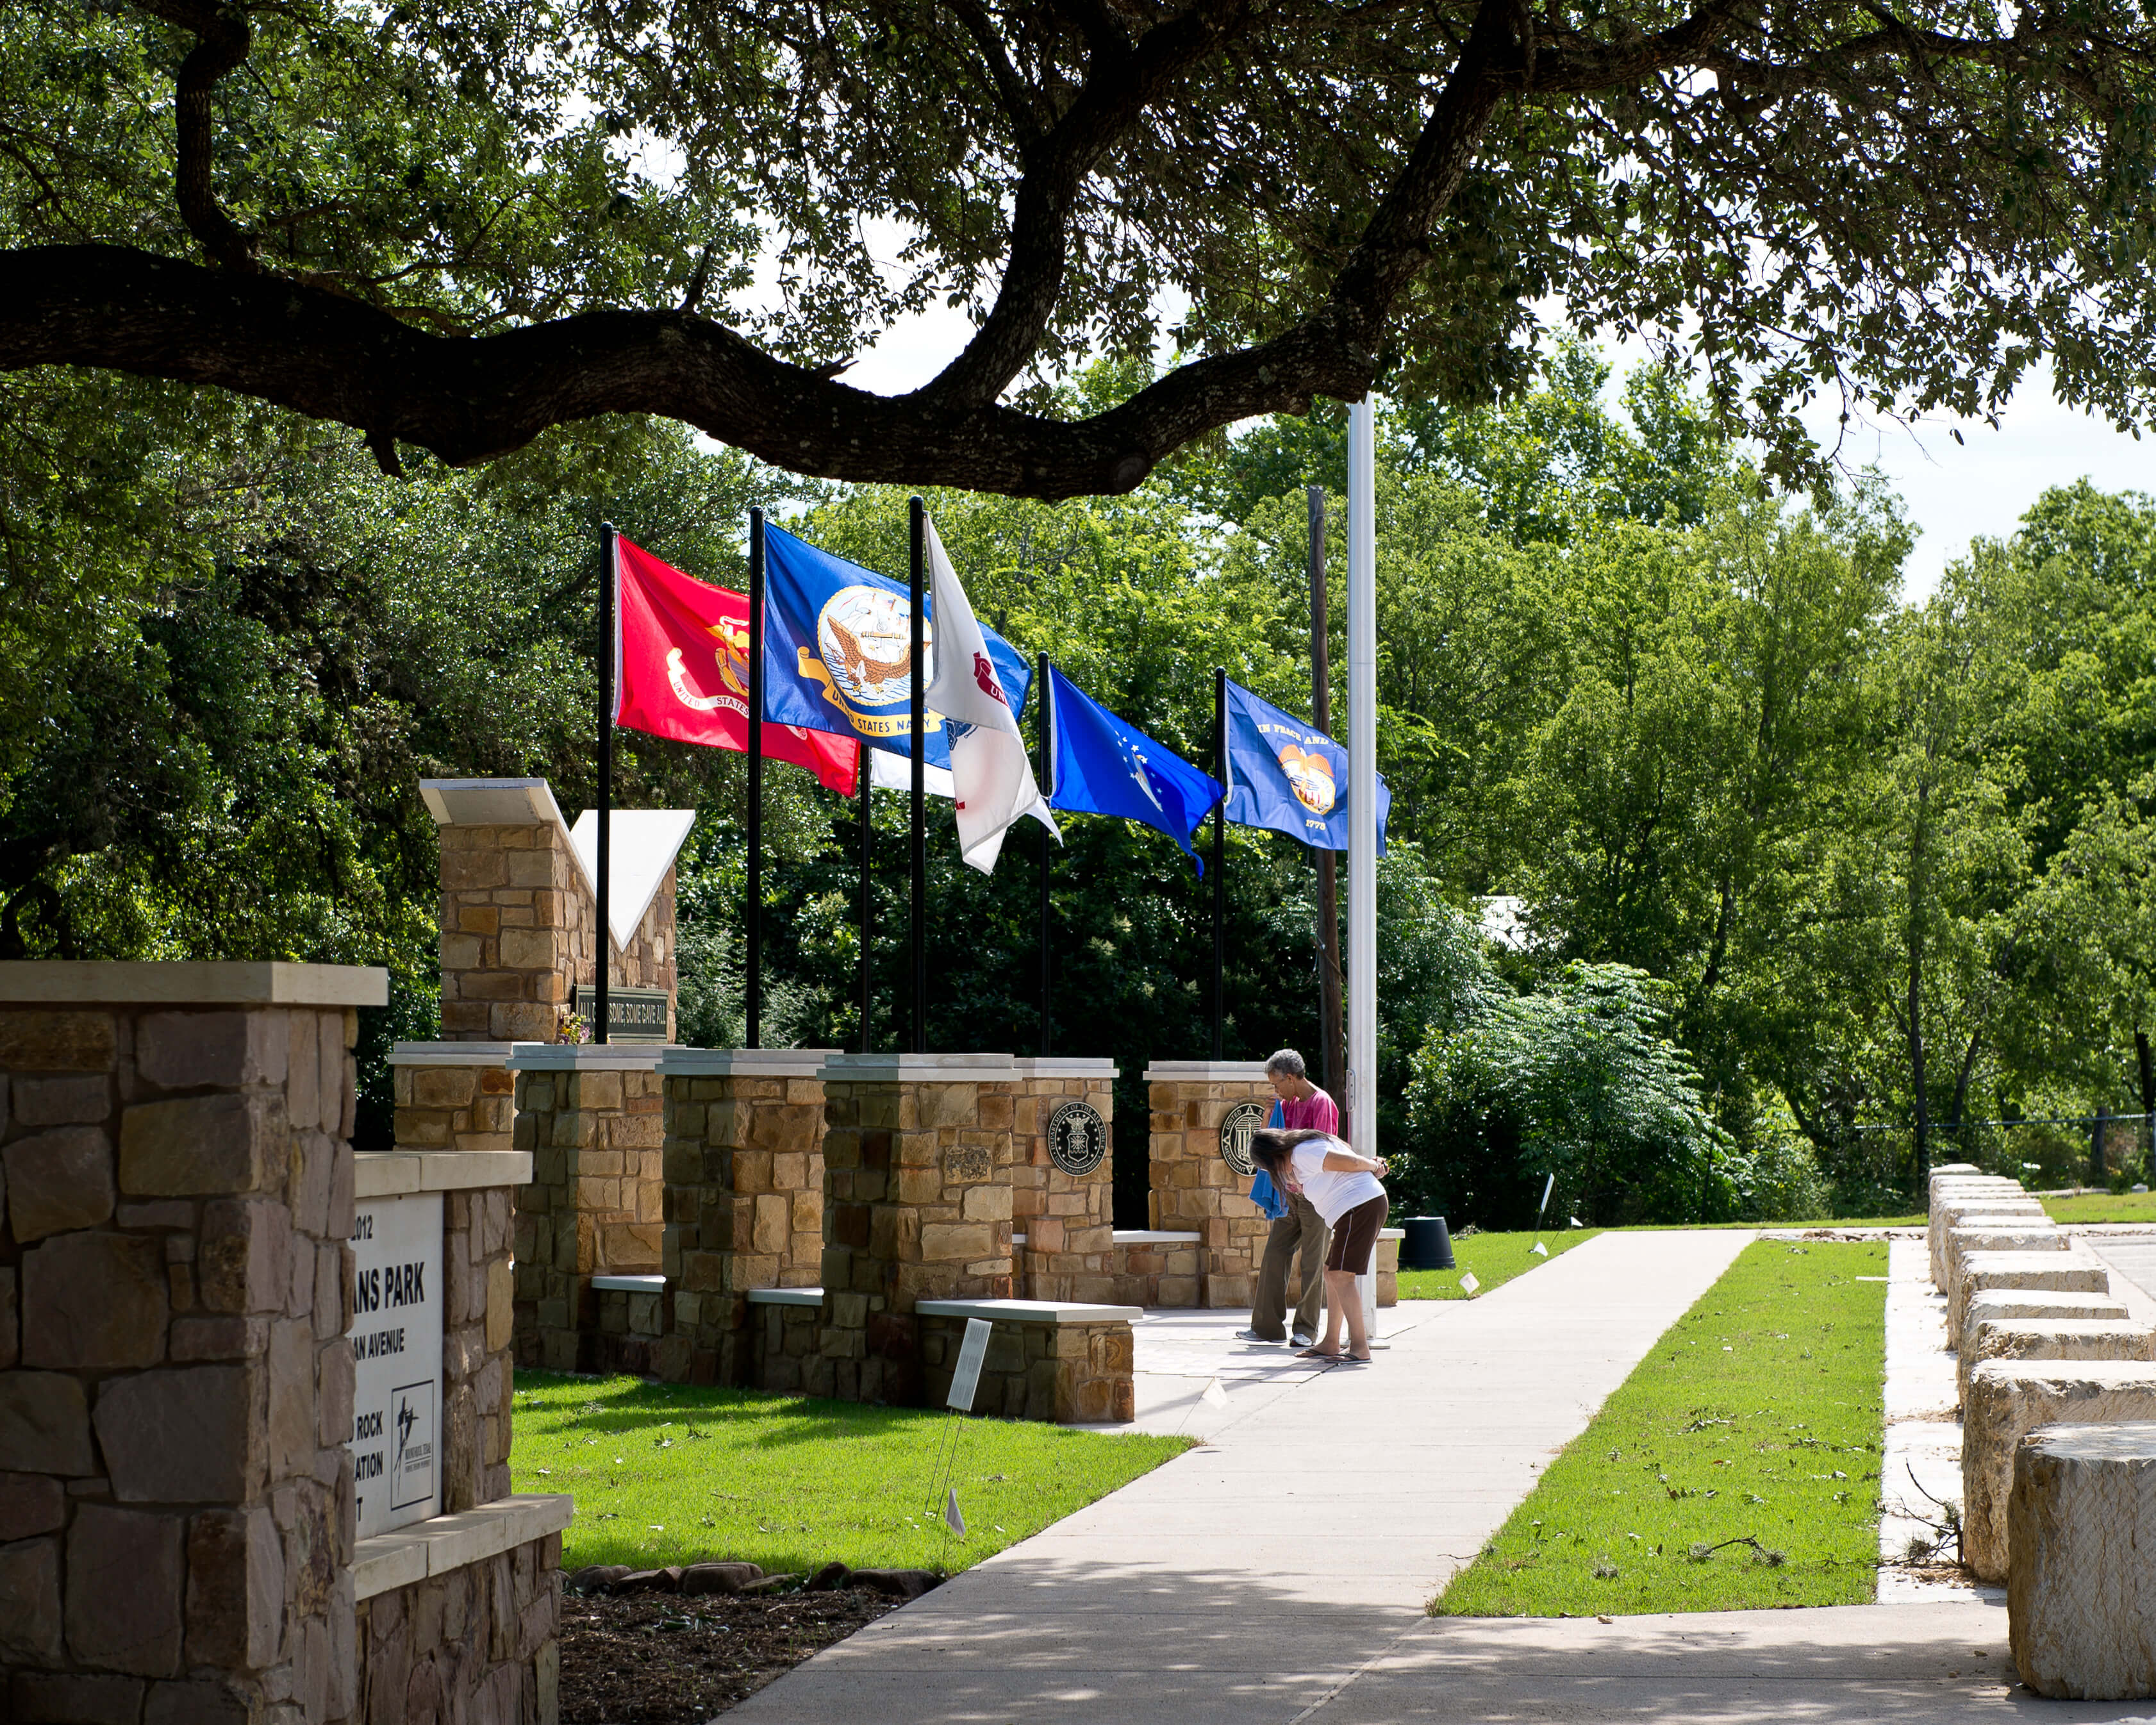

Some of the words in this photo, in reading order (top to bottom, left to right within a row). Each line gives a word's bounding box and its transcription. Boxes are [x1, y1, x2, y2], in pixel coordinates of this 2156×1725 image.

[674, 681, 700, 708] UNITED
[717, 697, 749, 715] STATES
[858, 718, 890, 733] STATES
[897, 718, 930, 731] NAY
[1257, 724, 1270, 733] IN
[1273, 724, 1302, 742] PEACE
[1304, 736, 1329, 745] AND
[626, 1003, 641, 1024] SOME
[642, 1004, 656, 1024] GAVE
[656, 1004, 666, 1025] ALL
[1081, 1104, 1092, 1113] THE
[1225, 1109, 1241, 1130] UNITED
[1224, 1145, 1246, 1173] MERCHANT
[351, 1214, 373, 1241] 012
[385, 1261, 425, 1309] PARK
[368, 1328, 404, 1359] AVENUE
[357, 1411, 383, 1441] ROCK
[355, 1451, 383, 1483] ATION
